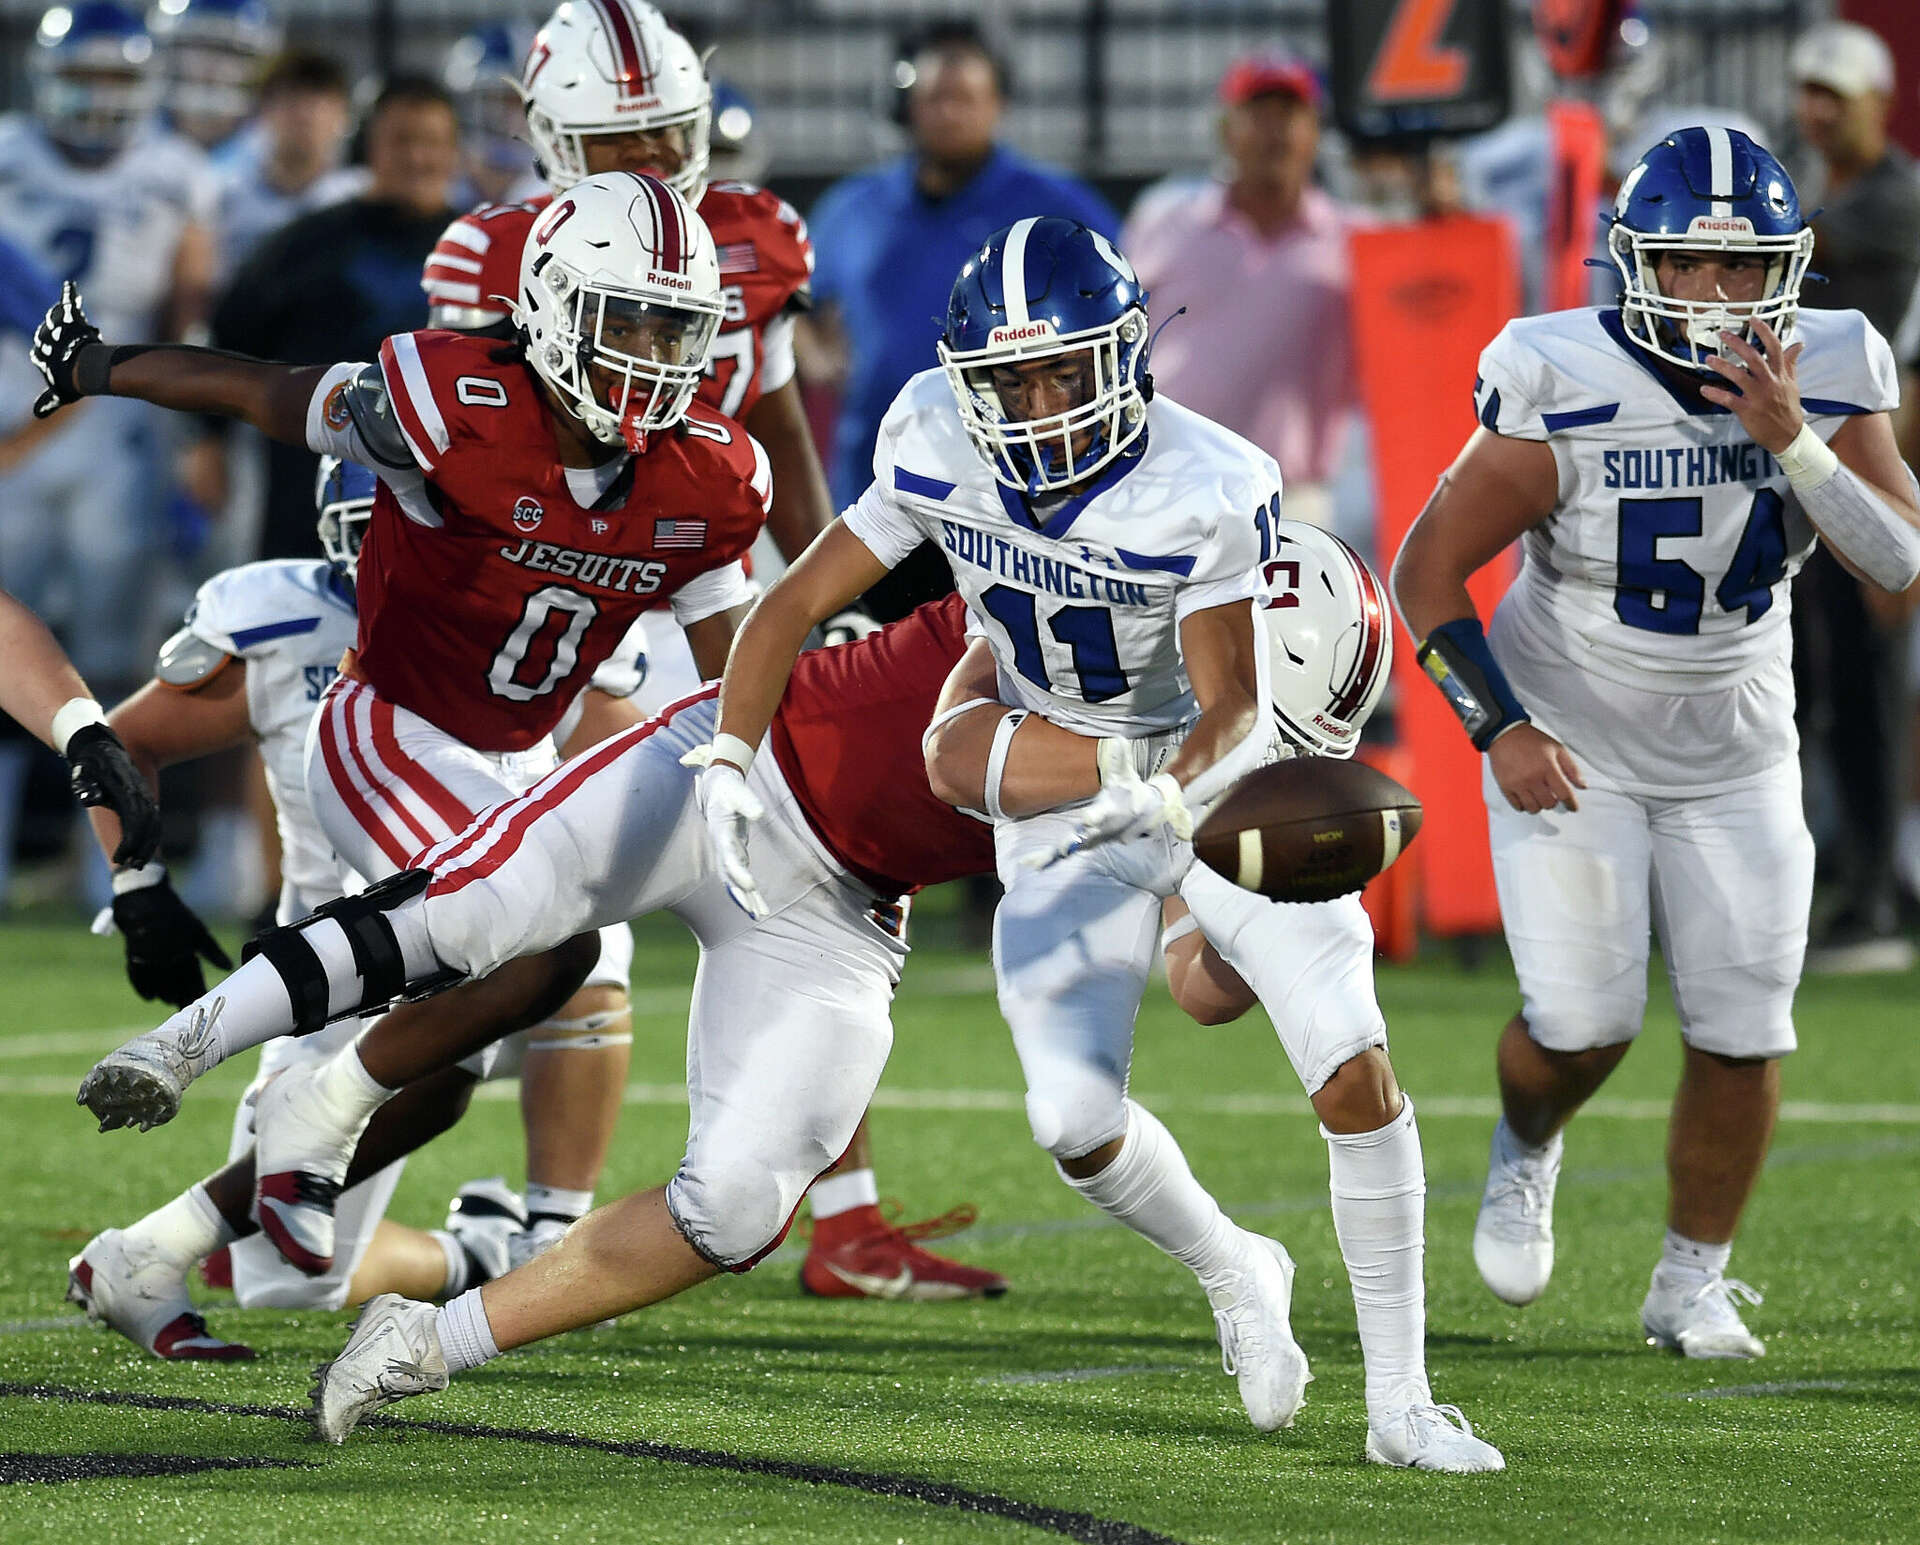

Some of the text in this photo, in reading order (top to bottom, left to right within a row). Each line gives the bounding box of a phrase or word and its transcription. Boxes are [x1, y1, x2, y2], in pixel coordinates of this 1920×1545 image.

[536, 199, 576, 247] 0
[647, 272, 692, 291] Riddell
[993, 324, 1046, 343] Riddell
[455, 376, 508, 407] 0
[681, 414, 733, 445] 0
[1604, 443, 1786, 489] SOUTHINGT
[513, 506, 543, 522] SCC
[499, 538, 668, 594] JESUITS
[941, 519, 1150, 607] SOUTHINGTON
[1614, 487, 1788, 635] 54
[487, 583, 599, 702] 0
[979, 583, 1132, 703] 11
[1311, 713, 1351, 739] Riddell
